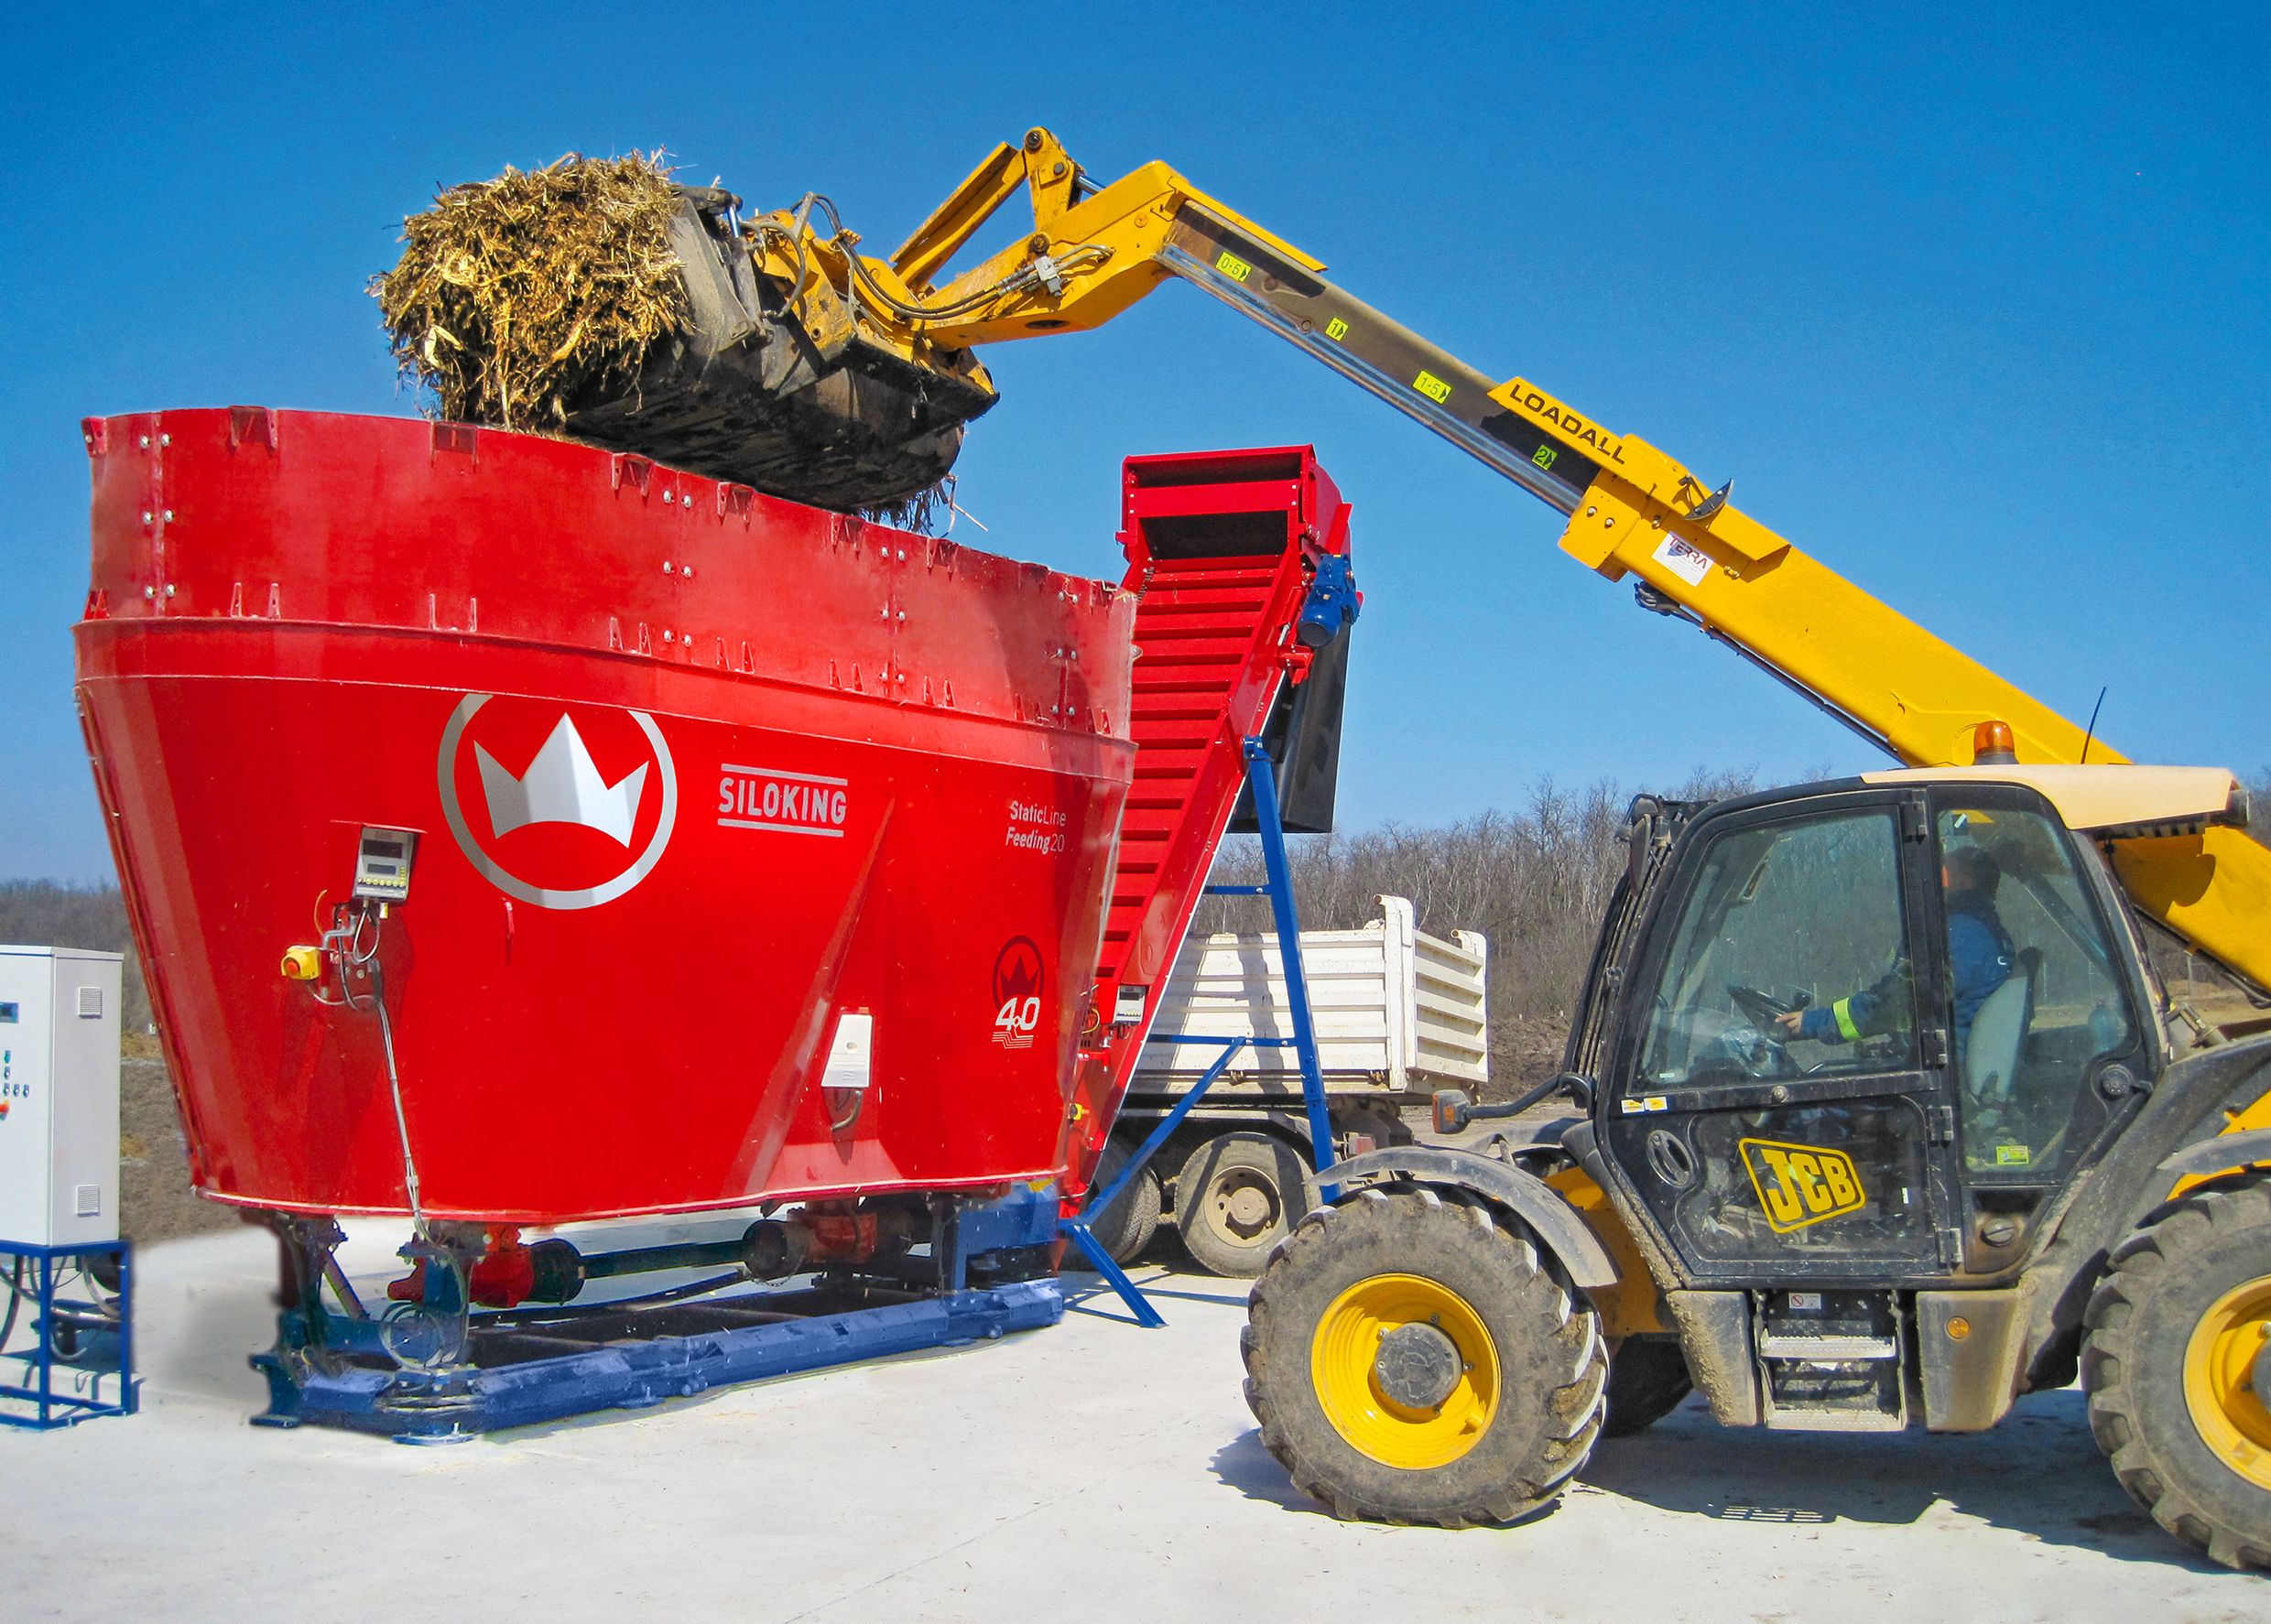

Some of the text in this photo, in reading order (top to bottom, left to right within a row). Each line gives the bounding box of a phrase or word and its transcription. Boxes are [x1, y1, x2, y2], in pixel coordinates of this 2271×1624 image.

[1509, 384, 1625, 465] LOADALL
[1536, 449, 1548, 463] 2
[718, 777, 847, 825] SILOKING
[1010, 800, 1067, 827] StaticLine
[1005, 826, 1065, 855] Feeding 20
[1760, 1148, 1856, 1222] JCB
